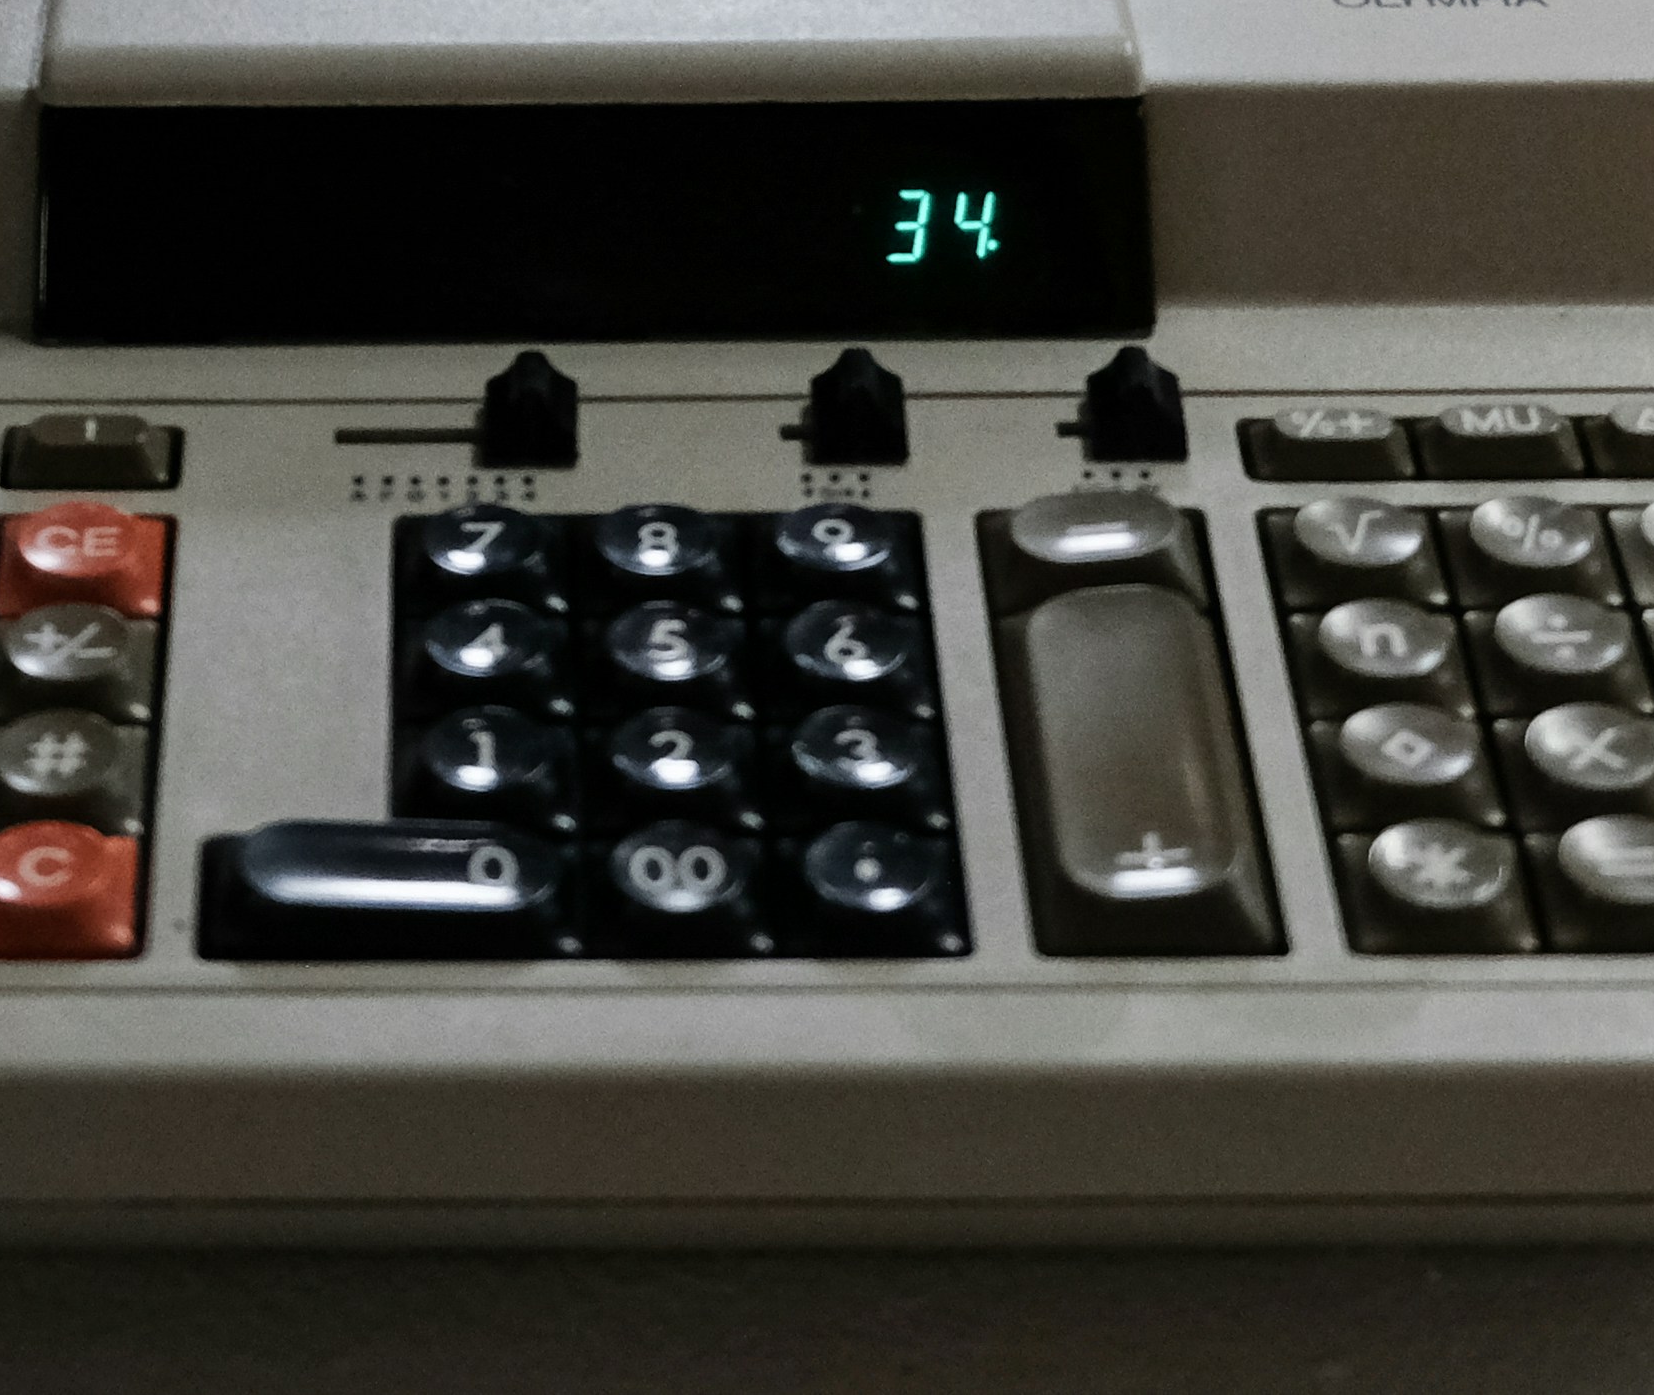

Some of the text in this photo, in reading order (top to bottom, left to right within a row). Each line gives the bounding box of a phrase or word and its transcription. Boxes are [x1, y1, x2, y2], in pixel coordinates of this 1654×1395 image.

[1460, 407, 1544, 434] MU
[34, 524, 122, 557] CE
[461, 521, 506, 559] 7
[637, 521, 678, 562] 8
[811, 517, 857, 557] 9
[1500, 511, 1562, 555] %
[459, 622, 508, 663] 4
[648, 618, 692, 663] 5
[823, 614, 872, 665] 6
[1358, 622, 1407, 659] n
[24, 732, 90, 779] #
[468, 730, 498, 771] 1
[649, 728, 699, 773] 2
[833, 728, 885, 772] 3
[18, 845, 77, 888] C
[466, 845, 520, 890] 0
[628, 845, 728, 893] 00
